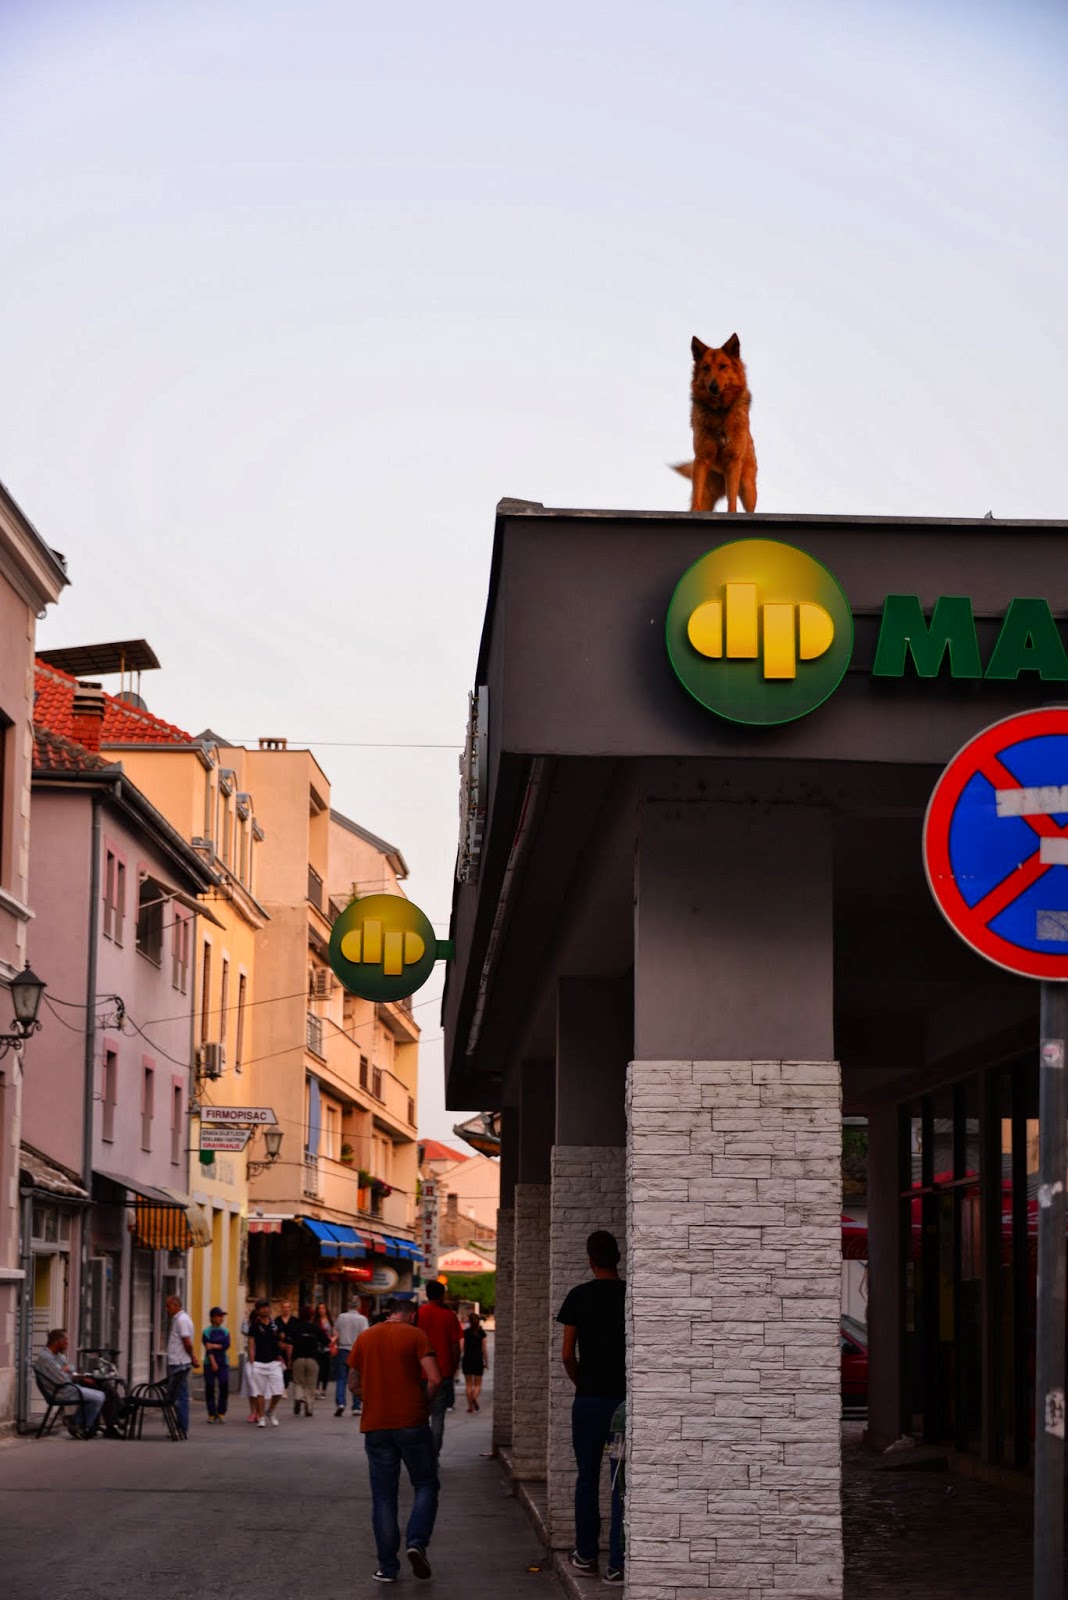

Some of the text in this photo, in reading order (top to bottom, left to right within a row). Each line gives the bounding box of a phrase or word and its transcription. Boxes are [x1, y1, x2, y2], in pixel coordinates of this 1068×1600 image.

[872, 594, 1068, 681] MA
[206, 1110, 267, 1120] FIRMOPISAC
[424, 1186, 434, 1268] HSTEL
